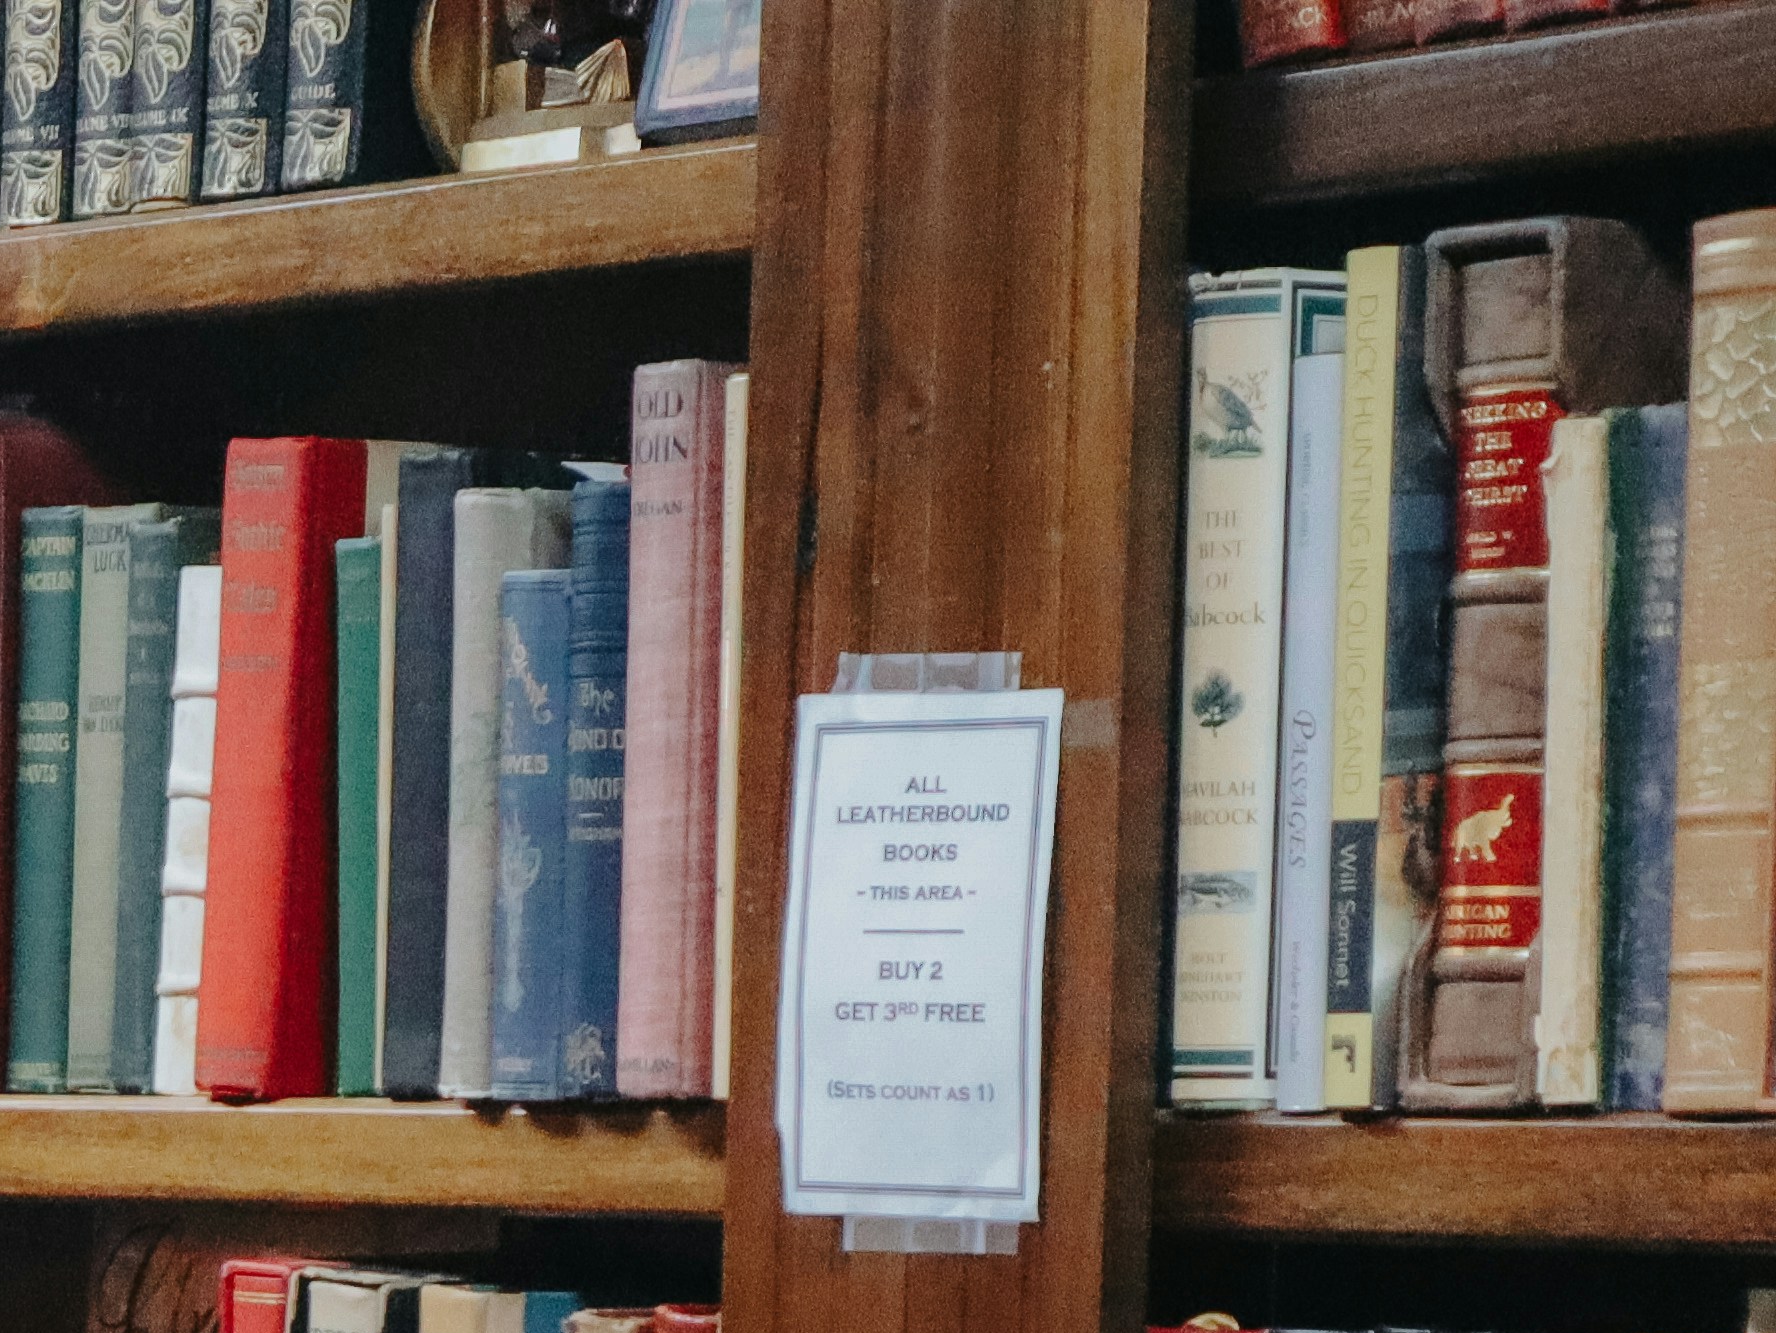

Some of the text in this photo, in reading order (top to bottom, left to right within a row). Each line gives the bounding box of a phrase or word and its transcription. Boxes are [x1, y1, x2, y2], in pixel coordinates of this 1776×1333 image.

[636, 389, 683, 420] OLD
[1205, 509, 1238, 528] THE
[1199, 540, 1246, 560] BEST
[1342, 294, 1379, 796] DUCK HUNTING IN QUICKSAND
[93, 547, 128, 574] LUCK
[1206, 571, 1233, 590] OF
[579, 681, 615, 716] The
[904, 775, 947, 794] ALL
[836, 803, 1011, 824] LEATHERBOUND
[882, 843, 959, 863] BOOKS
[1340, 842, 1359, 893] Will
[870, 885, 911, 901] THIS
[915, 885, 964, 901] AREA
[878, 960, 944, 981] BUY 2
[834, 1001, 987, 1024] GET 3RD FREE
[880, 1085, 942, 1101] COUNT
[947, 1086, 970, 1102] AS
[978, 1083, 995, 1103] 1)
